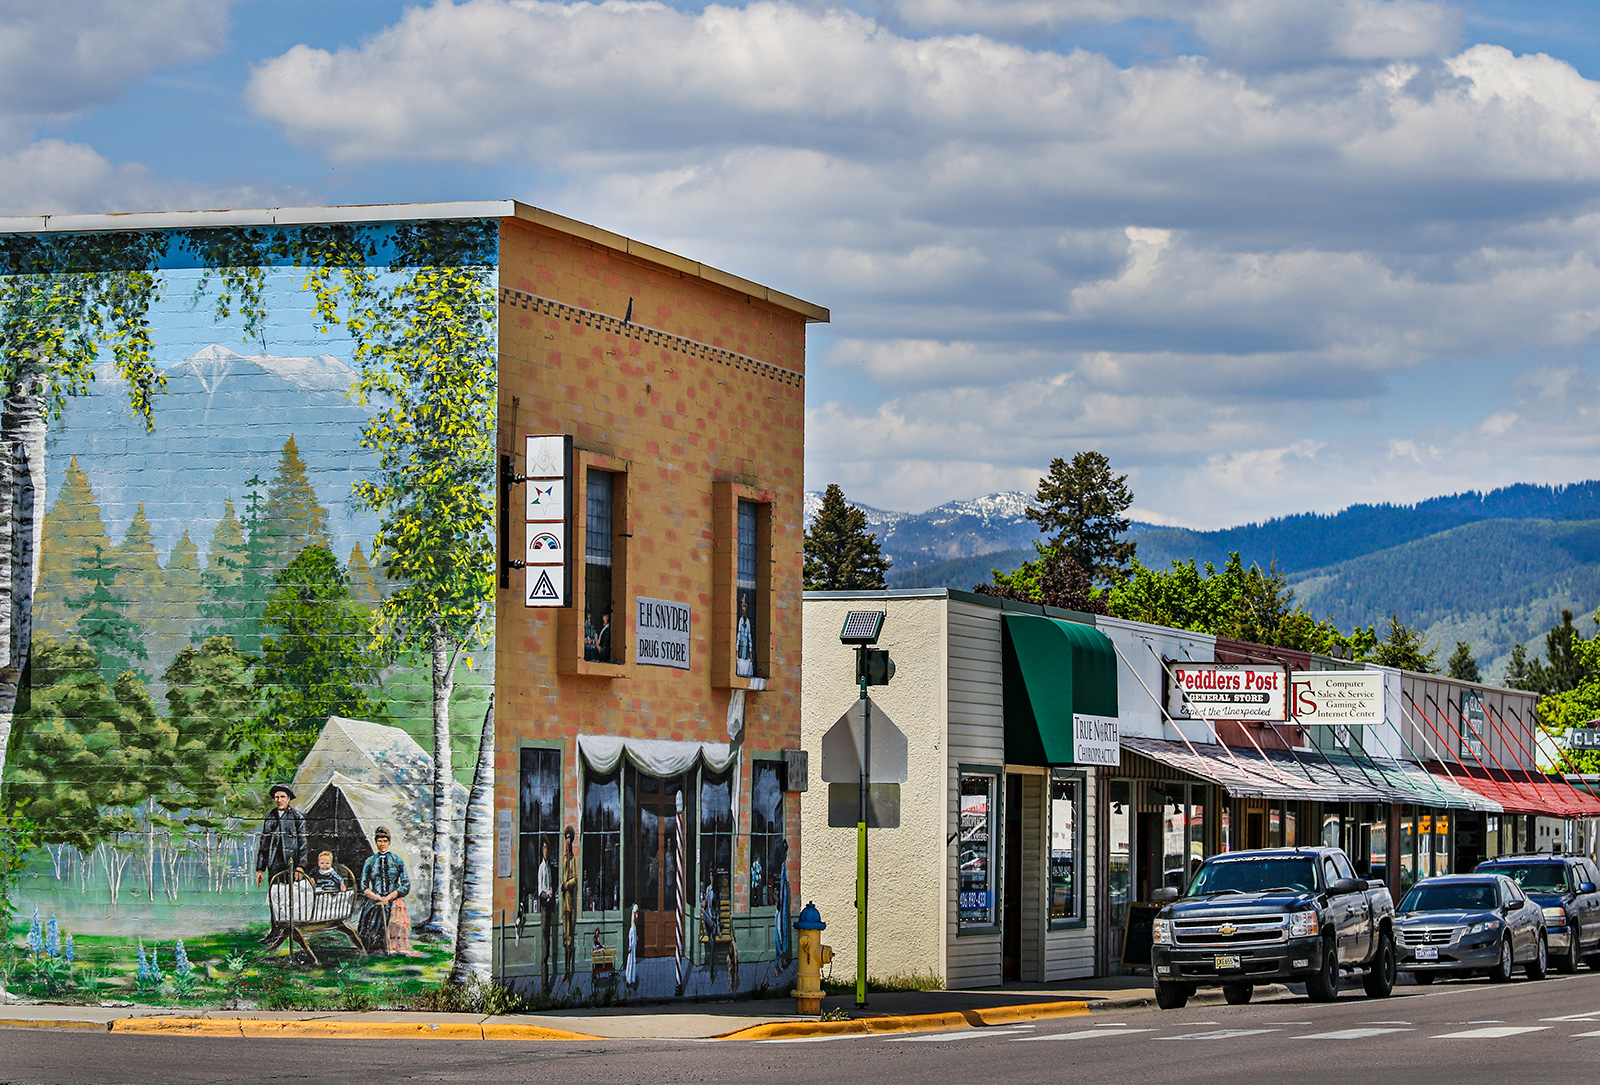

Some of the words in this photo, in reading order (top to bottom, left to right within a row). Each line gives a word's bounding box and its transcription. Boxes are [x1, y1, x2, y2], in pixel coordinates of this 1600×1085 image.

[655, 604, 688, 633] SNYDER
[639, 639, 660, 659] DRUG
[661, 641, 686, 662] STORE
[1175, 670, 1240, 690] Peddlers
[1244, 671, 1278, 690] Post
[1325, 679, 1364, 690] Computer
[1189, 693, 1231, 702] GENERAL
[1233, 694, 1263, 702] STORE
[1317, 690, 1336, 699] Sales
[1338, 690, 1346, 699] &
[1347, 690, 1374, 699] Service
[1208, 706, 1221, 717] the
[1222, 706, 1272, 718] Unexpected
[1326, 701, 1356, 712] Gaming
[1358, 701, 1366, 709] &
[1317, 709, 1347, 718] Internet
[1349, 709, 1375, 718] Center
[1075, 716, 1093, 740] TRUE
[1078, 744, 1116, 764] CHIROPRACTIC
